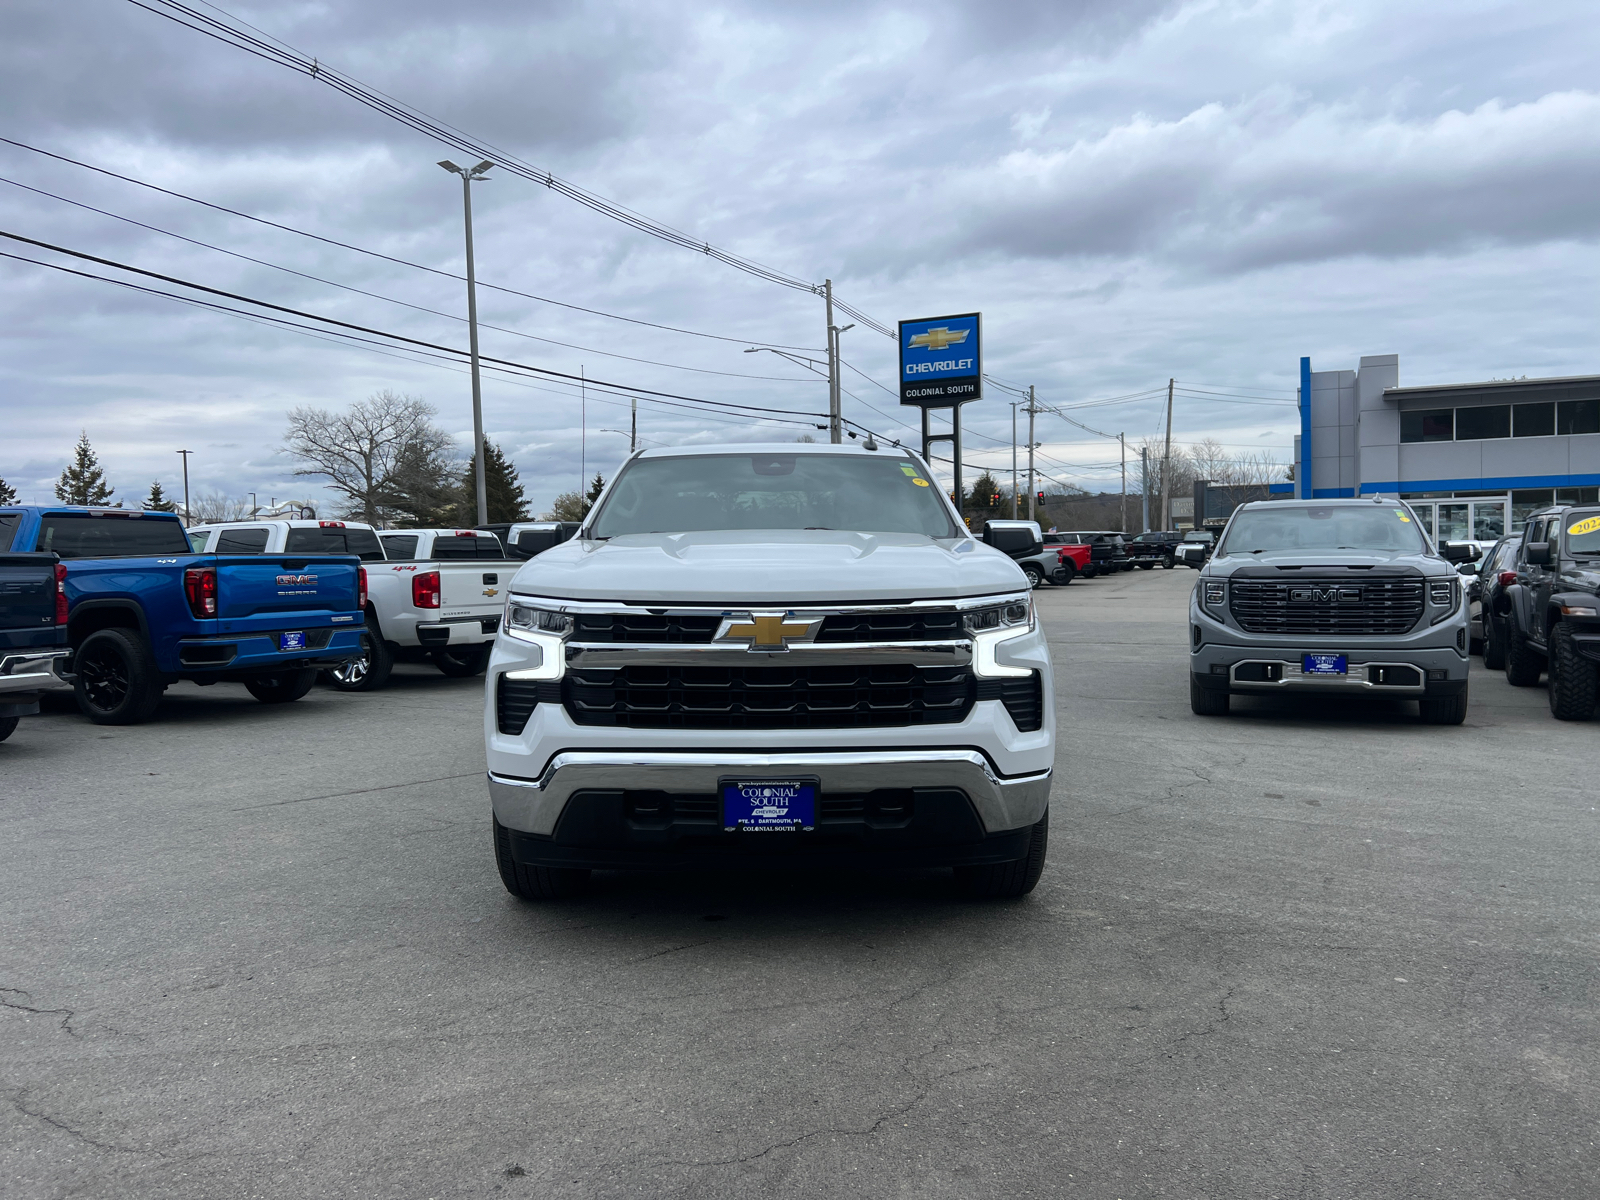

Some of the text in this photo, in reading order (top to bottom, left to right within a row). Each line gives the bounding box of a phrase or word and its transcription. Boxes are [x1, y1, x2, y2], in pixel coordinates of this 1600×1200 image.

[906, 359, 973, 374] CHEVROLET
[906, 385, 974, 397] COLONIAL SOUTH
[276, 574, 318, 586] GMC
[1290, 589, 1360, 601] GMC
[741, 788, 798, 797] COLONIAL
[750, 797, 789, 806] SOUTH
